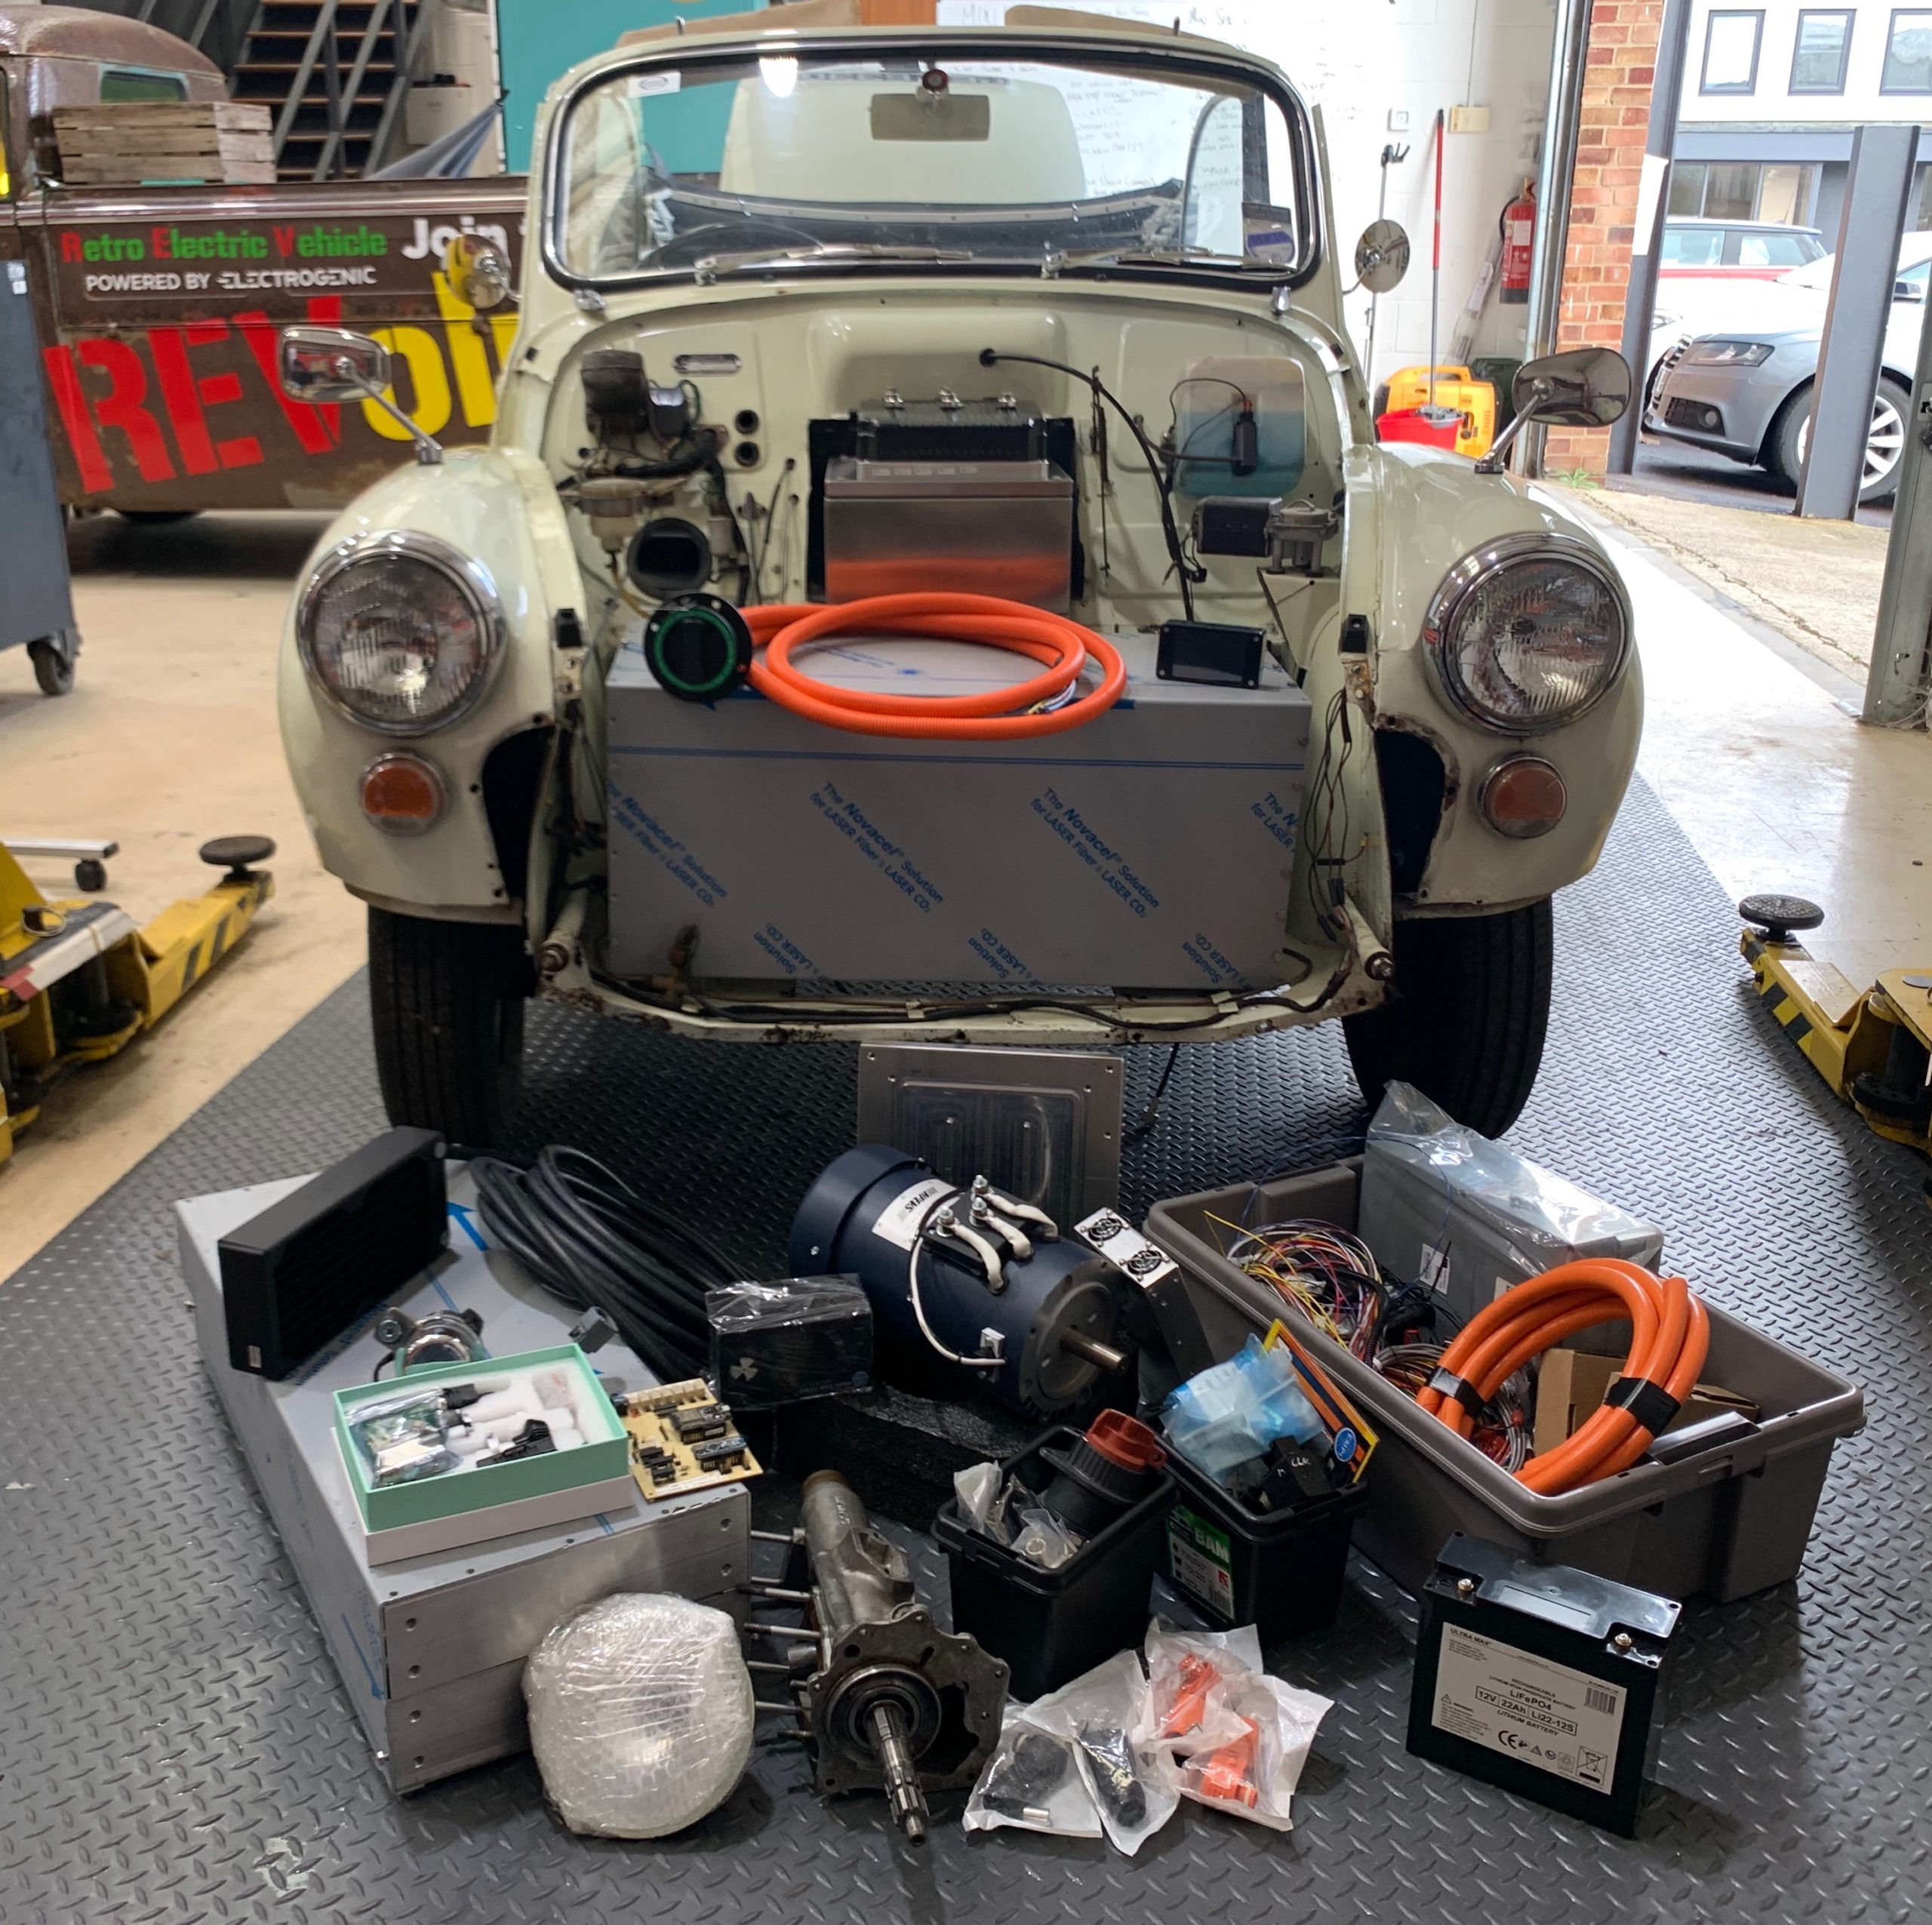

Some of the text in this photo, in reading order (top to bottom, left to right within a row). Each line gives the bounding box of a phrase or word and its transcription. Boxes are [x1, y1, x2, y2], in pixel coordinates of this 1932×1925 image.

[60, 224, 389, 263] Retro Electric Vehicle
[85, 266, 377, 292] POWERED BY ELECTROGENIC
[1264, 792, 1283, 815] The
[810, 792, 826, 809] for
[824, 807, 856, 838] LASER
[854, 835, 879, 860] Fiber
[884, 865, 915, 896] LASER
[823, 781, 843, 804] The
[901, 860, 943, 903] Solution
[1251, 802, 1294, 849] for LASER
[1030, 798, 1047, 814] for
[1044, 812, 1075, 844] LASER
[1072, 840, 1097, 866] Fiber
[1101, 869, 1132, 902] LASER
[1044, 786, 1063, 810] The
[1118, 865, 1159, 909] Solution
[753, 932, 796, 974] Solution
[968, 936, 1010, 979] Solution
[995, 944, 1026, 975] LASER
[1182, 941, 1223, 983] Solution
[1209, 949, 1240, 979] LASER
[1450, 1627, 1472, 1641] ULTRA
[1478, 1690, 1574, 1733] 12V 22Ah Li22-12S
[1509, 1689, 1552, 1711] LiFePO4
[1497, 1708, 1526, 1726] LITHIUM
[1525, 1719, 1559, 1737] BATTERY
